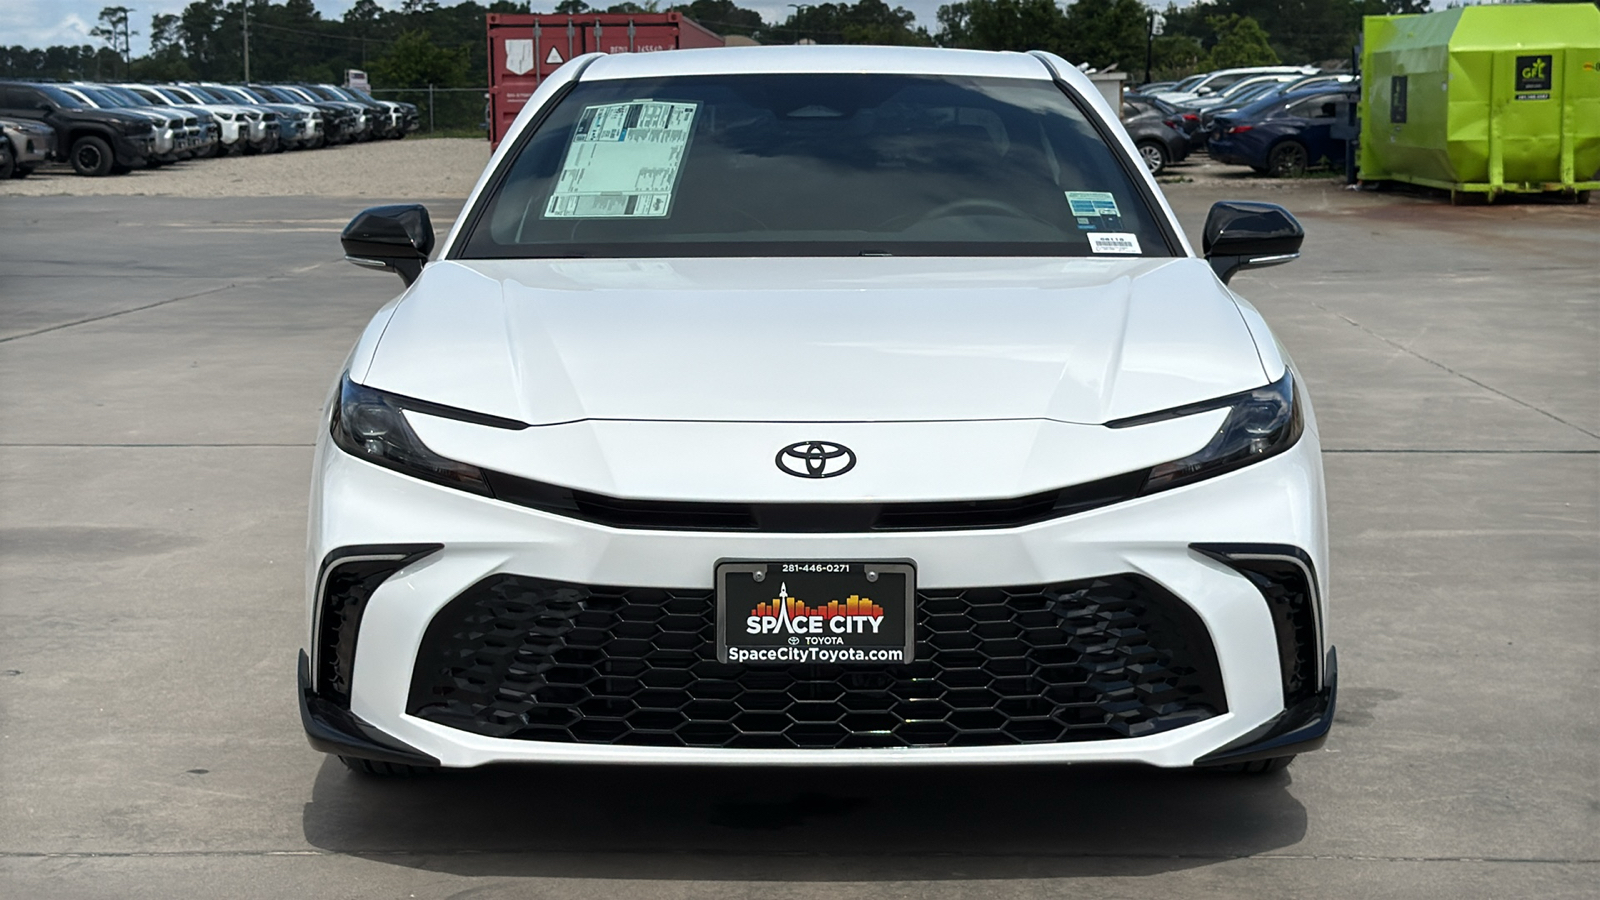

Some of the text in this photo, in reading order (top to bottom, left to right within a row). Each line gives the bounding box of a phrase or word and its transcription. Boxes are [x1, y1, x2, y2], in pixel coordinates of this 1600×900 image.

[1522, 65, 1544, 79] GFL
[782, 564, 850, 573] 281-446-0271
[746, 613, 884, 634] SPACE CITY
[804, 636, 844, 645] TOYOTA
[728, 646, 903, 663] SpaceCityToyota.com
